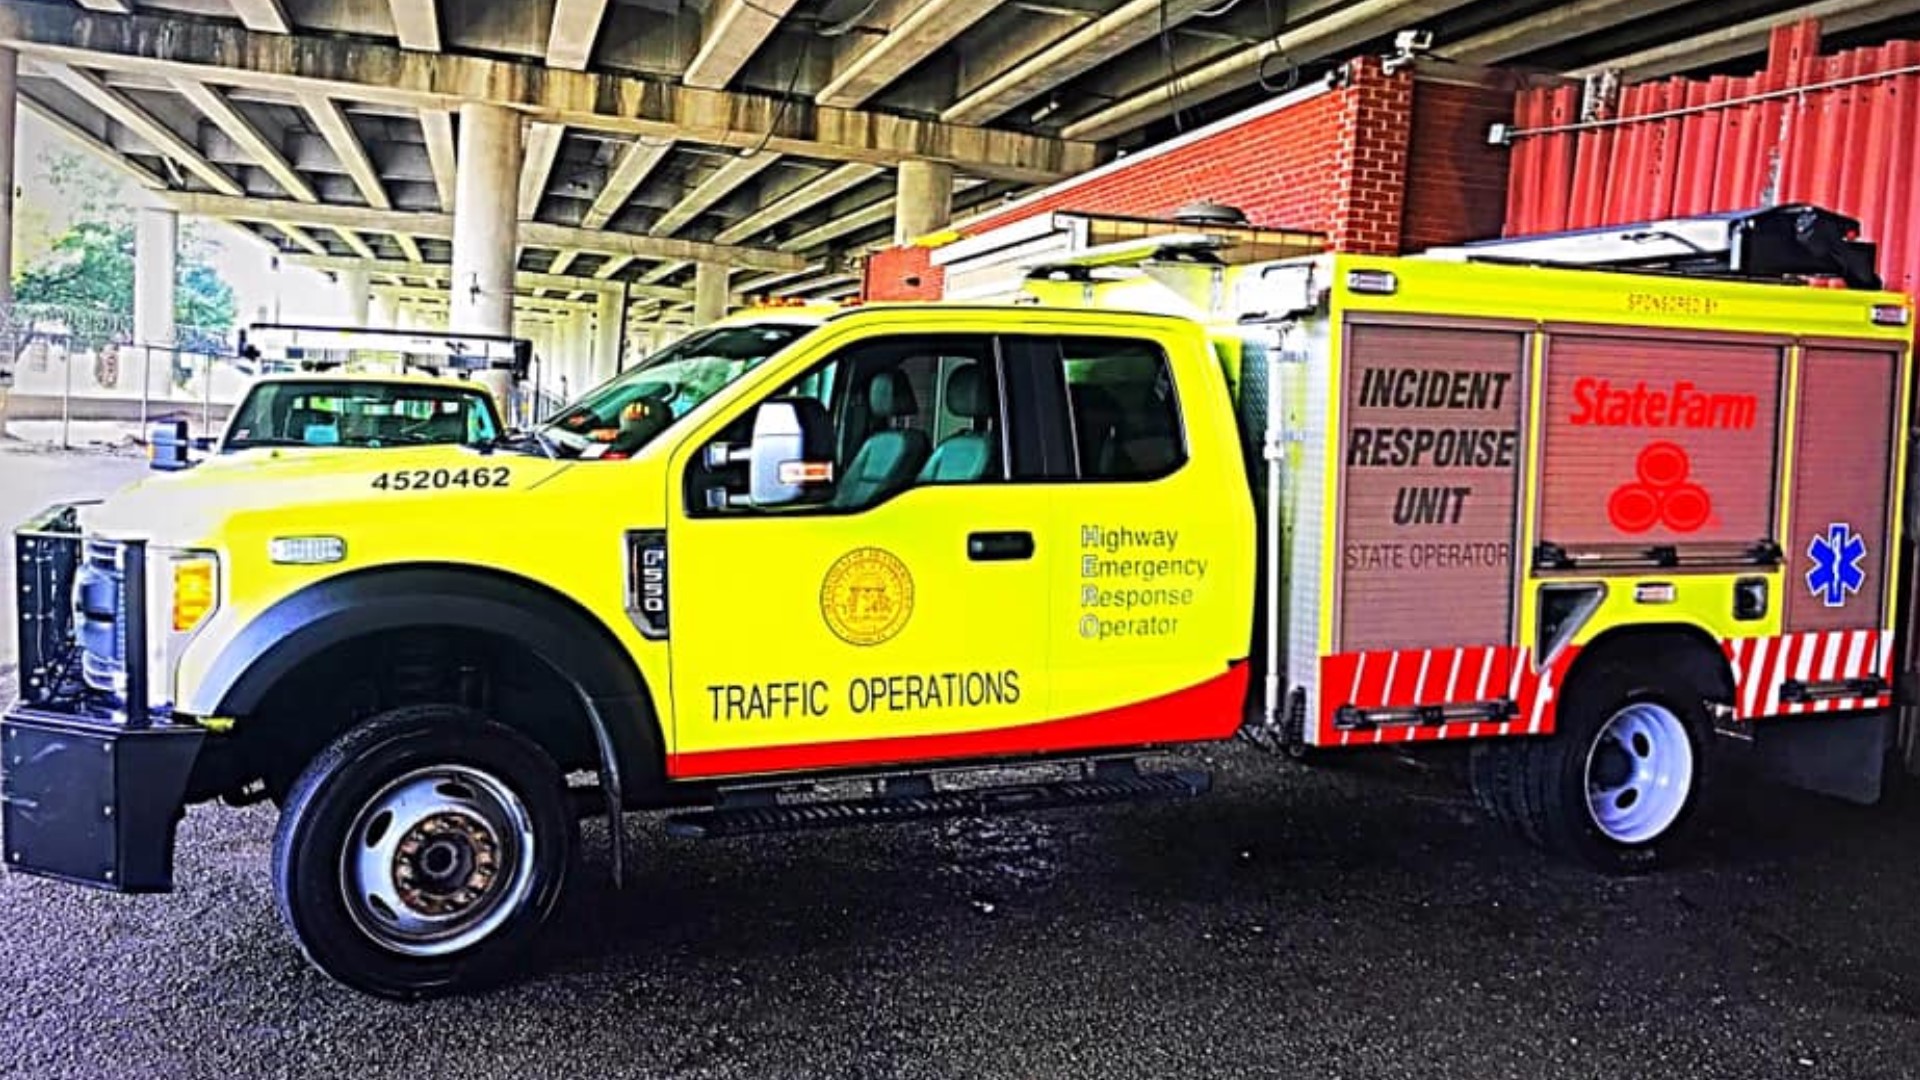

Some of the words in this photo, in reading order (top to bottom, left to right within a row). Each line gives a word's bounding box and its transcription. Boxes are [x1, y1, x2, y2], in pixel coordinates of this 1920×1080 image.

[1359, 368, 1511, 409] INCIDENT
[1348, 428, 1518, 467] RESPONSE
[371, 466, 511, 490] 4520462
[1394, 487, 1472, 526] UNIT
[1081, 525, 1178, 553] Highway
[1081, 554, 1208, 581] Emergency
[1346, 544, 1403, 570] STATE
[1411, 543, 1510, 569] OPERATOR
[1081, 583, 1193, 611] Response
[1080, 613, 1178, 640] Operator
[708, 680, 829, 722] TRAFFIC
[849, 670, 1021, 714] OPERATIONS
